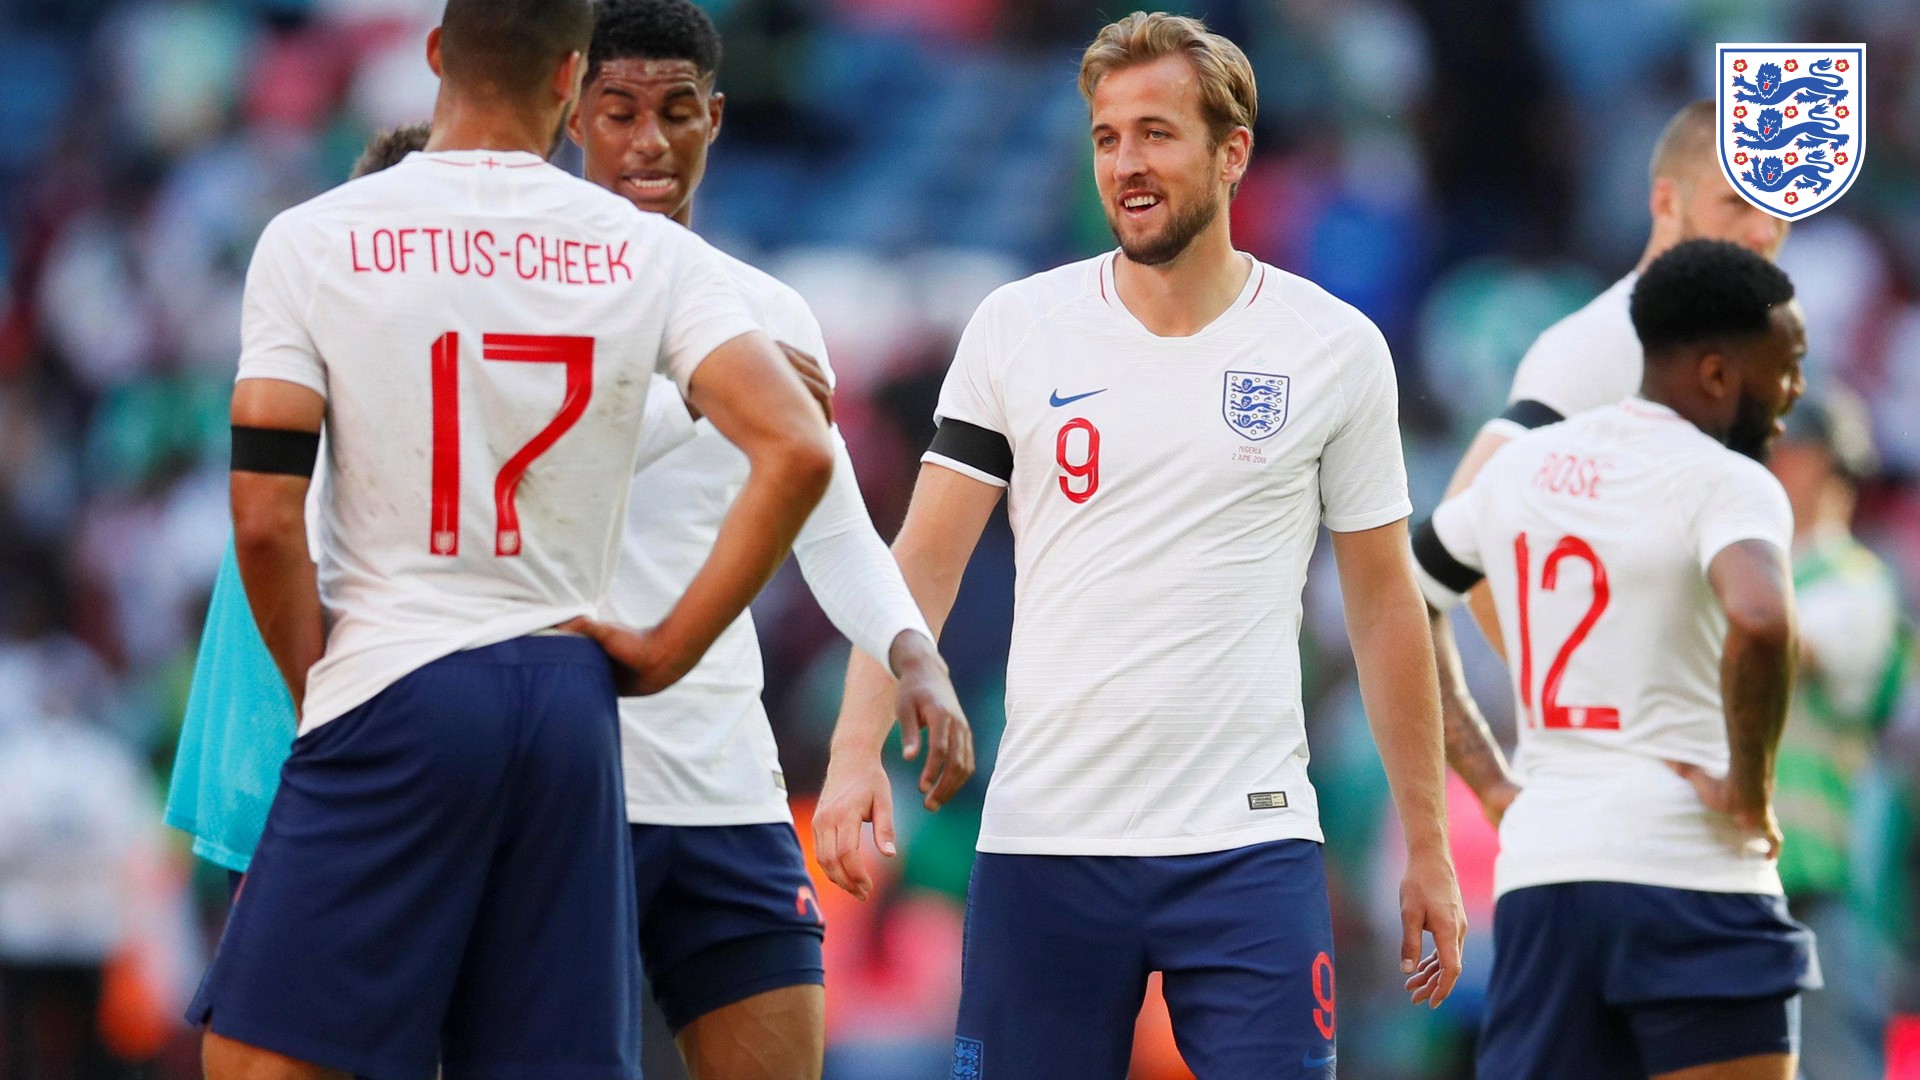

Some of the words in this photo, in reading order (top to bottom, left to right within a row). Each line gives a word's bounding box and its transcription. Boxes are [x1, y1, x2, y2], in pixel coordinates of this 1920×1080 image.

[351, 229, 633, 285] LOFTUS-CHEEK
[430, 331, 595, 557] 17
[1056, 417, 1100, 503] 9
[1239, 446, 1262, 455] NIGERIA
[1531, 453, 1614, 499] ROSE
[1514, 531, 1621, 730] 12
[1312, 951, 1336, 1040] 9
